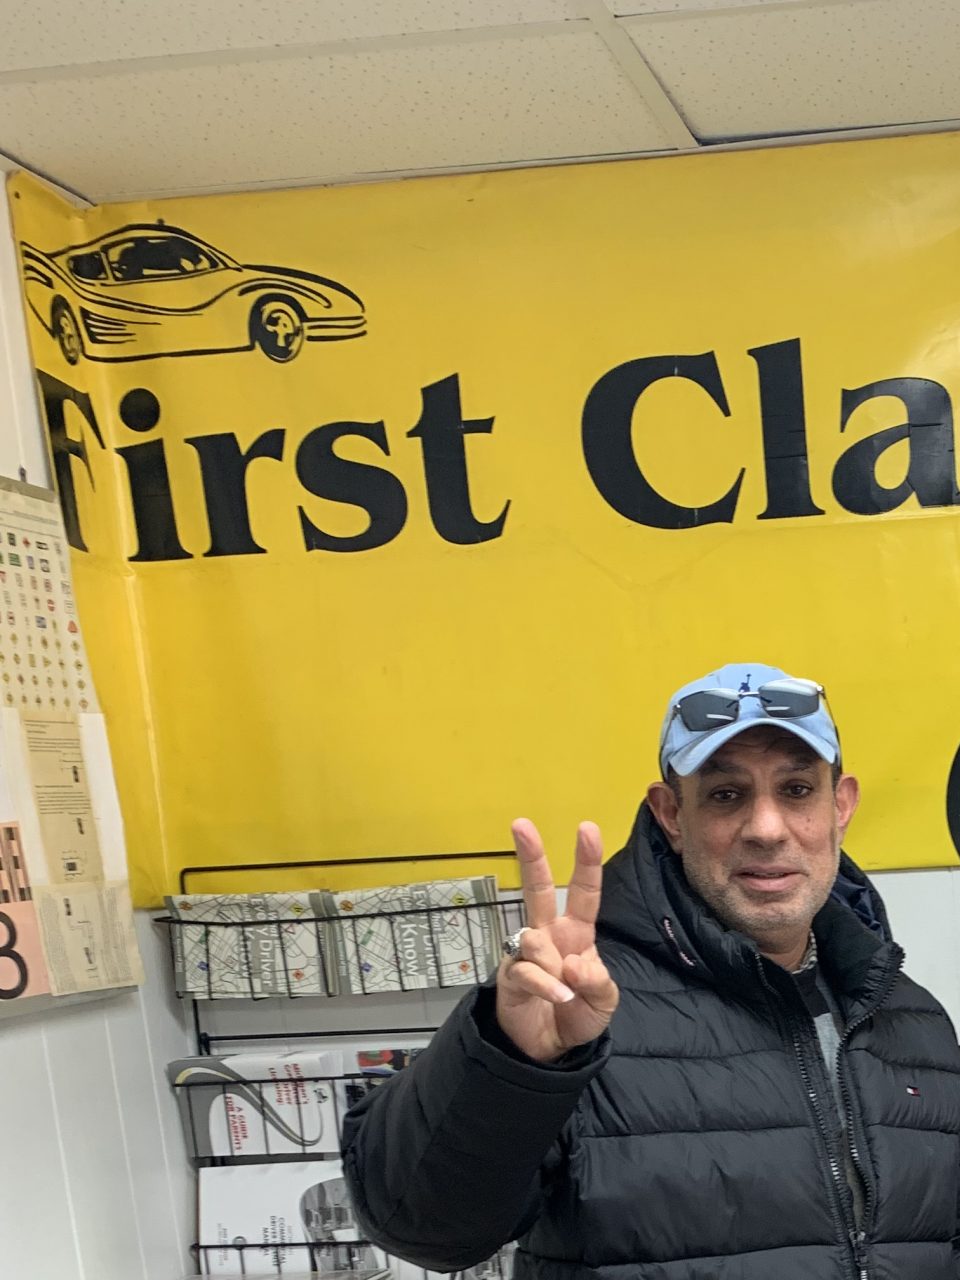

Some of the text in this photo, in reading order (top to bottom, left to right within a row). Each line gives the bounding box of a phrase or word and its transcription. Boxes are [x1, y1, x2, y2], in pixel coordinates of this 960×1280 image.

[36, 367, 512, 563] First
[251, 898, 269, 936] Evey
[412, 890, 430, 930] Evry
[402, 923, 419, 976] Know
[262, 1226, 270, 1256] MANAL
[278, 1216, 288, 1264] COMMCIAL
